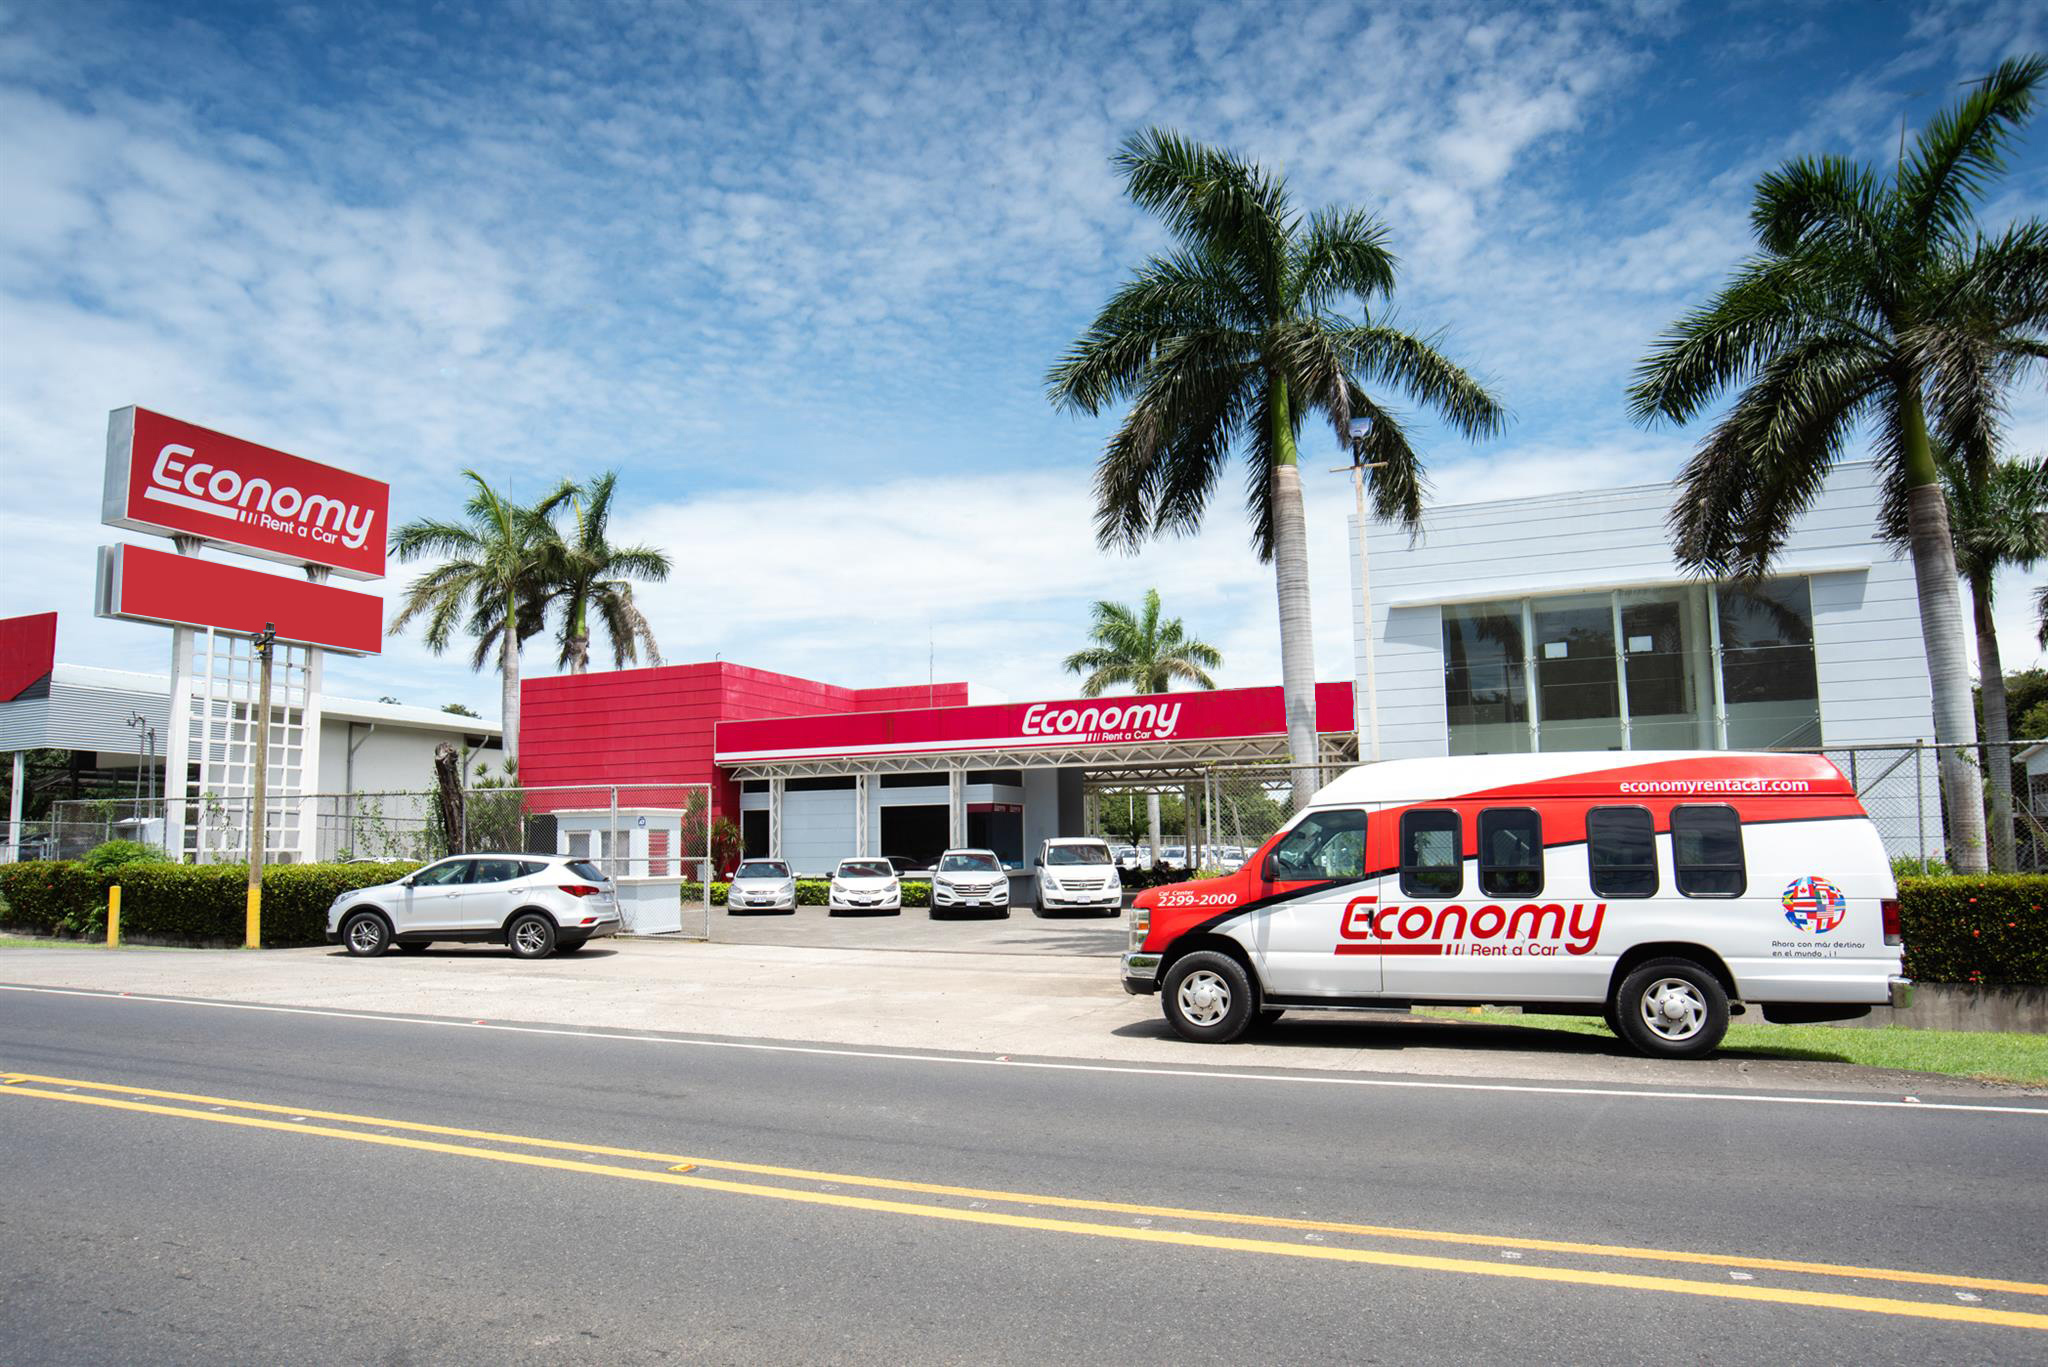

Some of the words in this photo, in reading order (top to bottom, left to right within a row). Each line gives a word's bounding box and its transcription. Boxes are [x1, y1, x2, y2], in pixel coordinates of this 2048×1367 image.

[152, 443, 375, 549] Economy
[260, 514, 294, 534] Rent
[298, 525, 307, 537] a
[311, 527, 338, 545] Car
[1021, 703, 1182, 738] Economy
[1102, 731, 1123, 741] Rent
[1125, 732, 1132, 740] a
[1134, 730, 1152, 739] Car
[1619, 779, 1809, 794] economyrentacar.com
[1157, 893, 1237, 907] 2299-2000
[1172, 889, 1194, 897] Center
[1340, 896, 1607, 956] Economy
[1470, 943, 1508, 956] Rent
[1512, 945, 1522, 956] a
[1528, 943, 1559, 956] Car
[1771, 940, 1795, 948] Ahora
[1833, 941, 1866, 949] destinos
[1794, 950, 1822, 958] mundo
